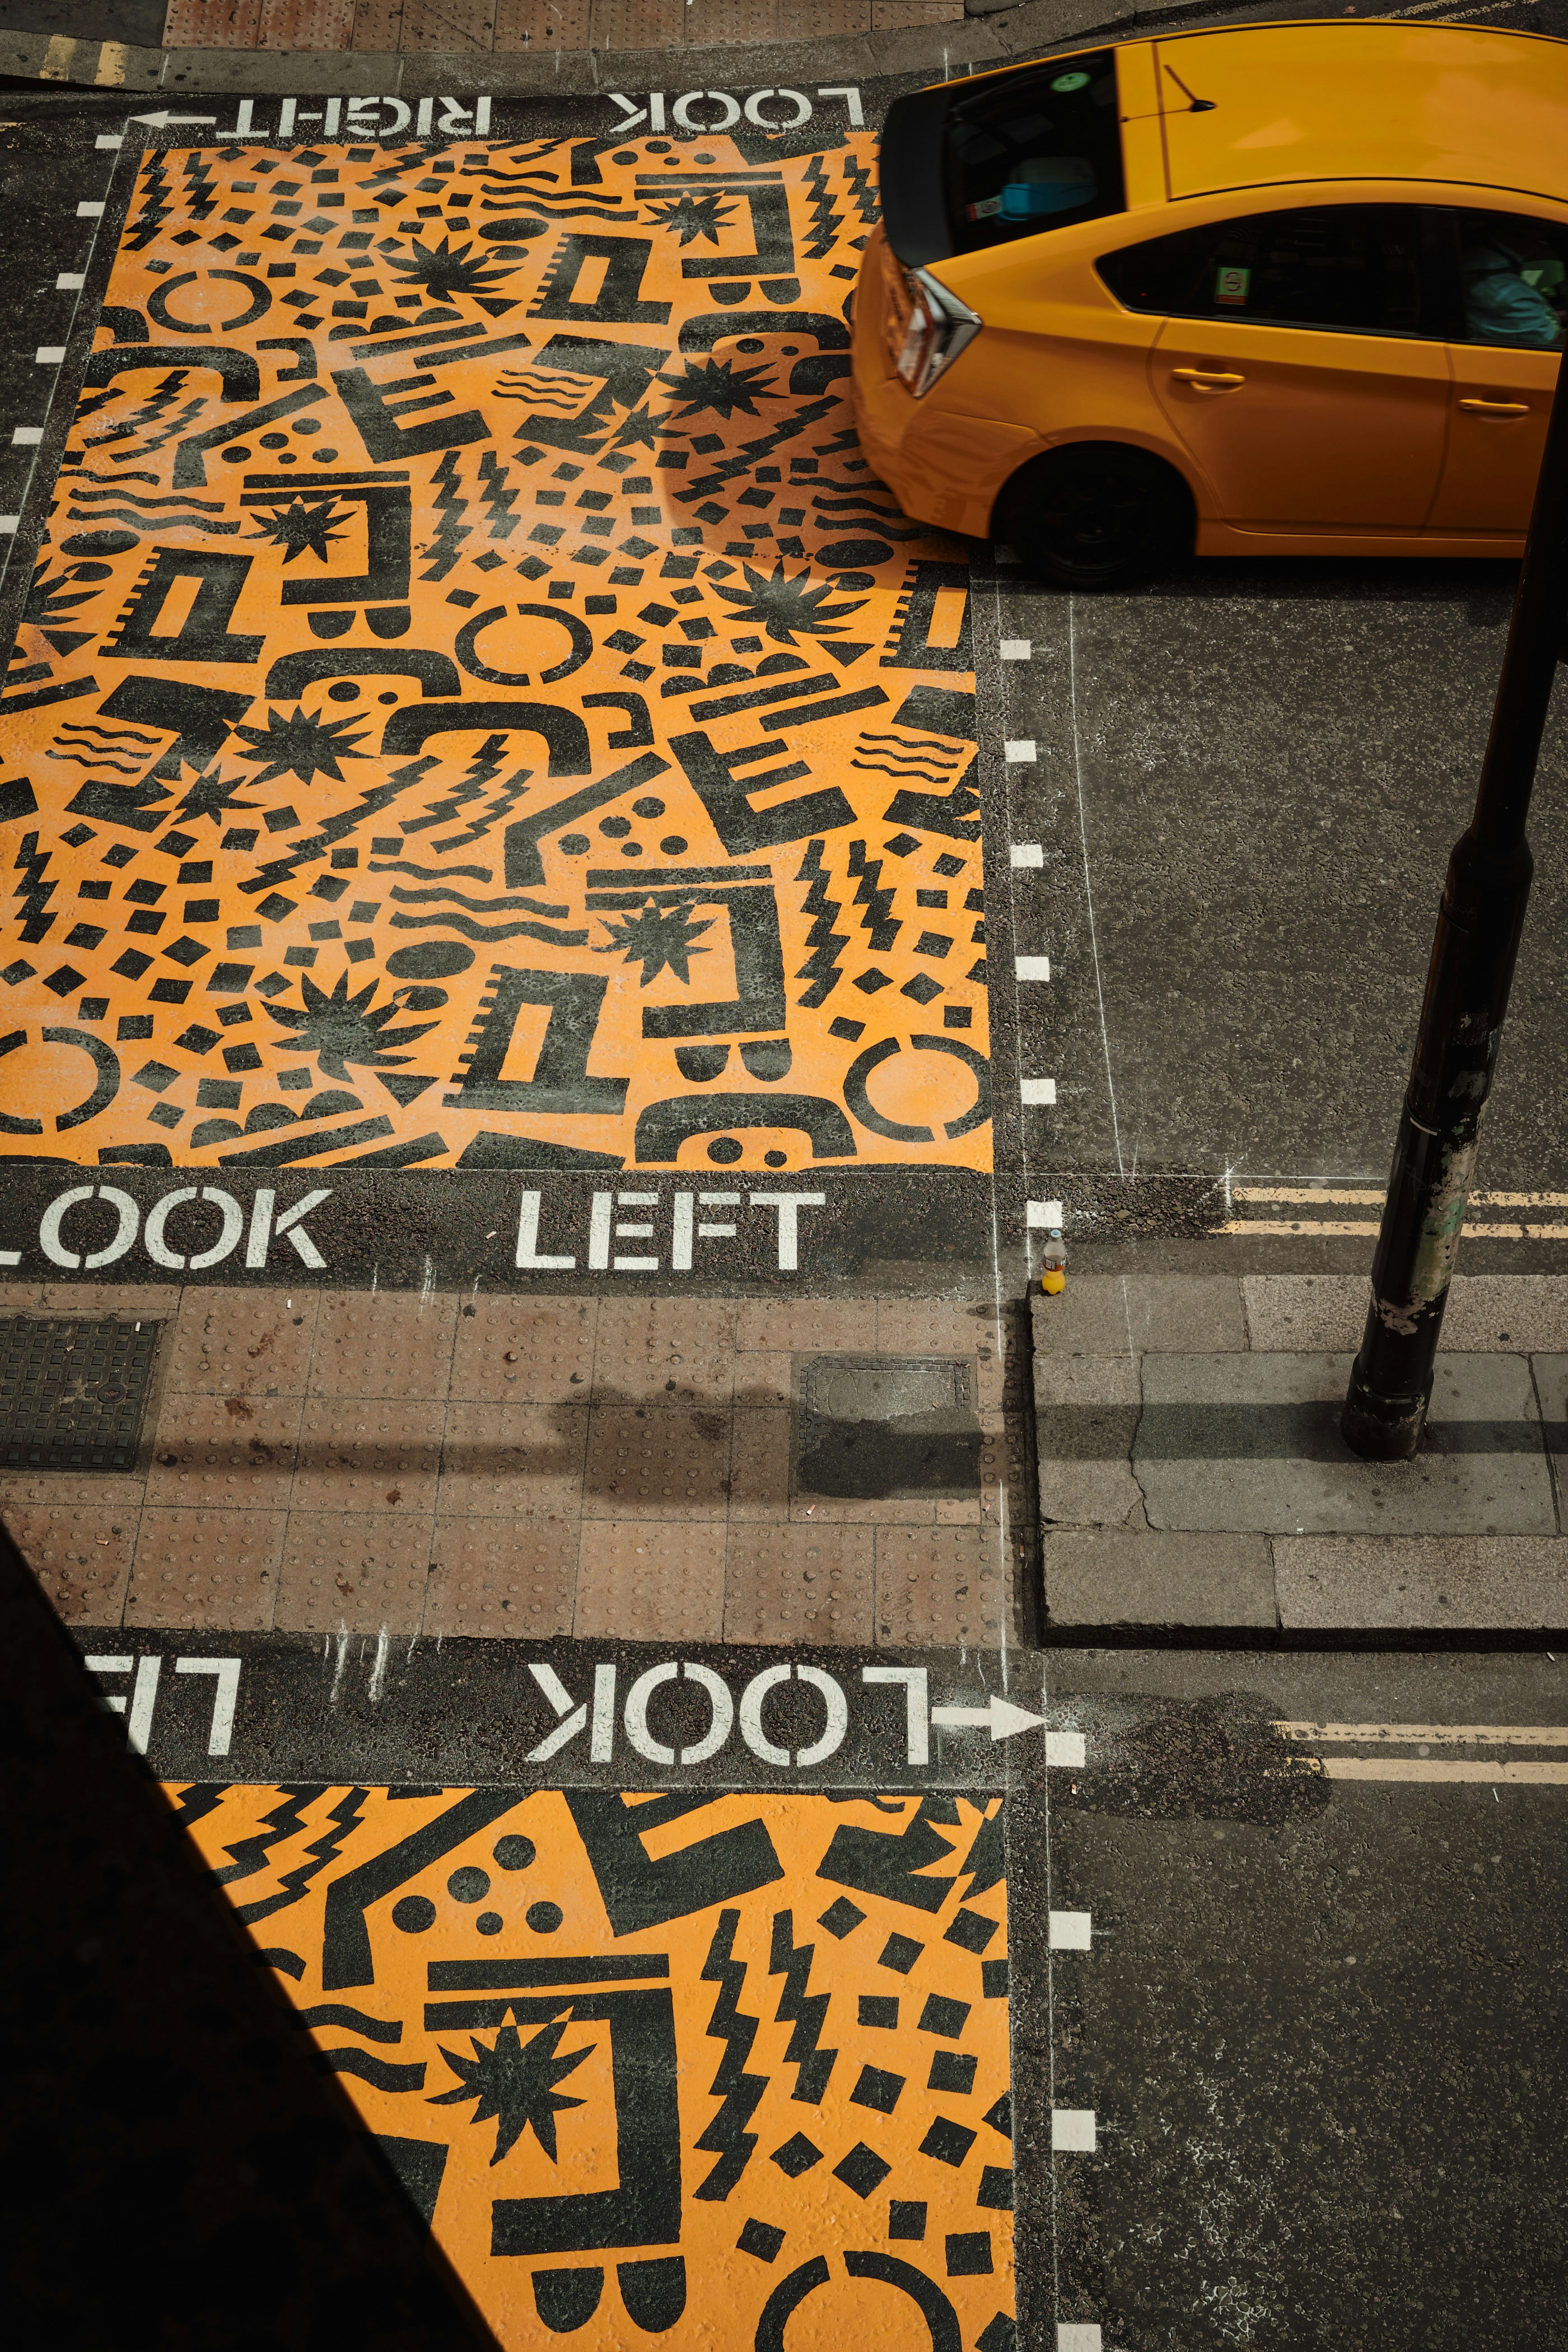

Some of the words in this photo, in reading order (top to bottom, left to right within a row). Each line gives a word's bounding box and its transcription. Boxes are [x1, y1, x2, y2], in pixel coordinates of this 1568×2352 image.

[216, 96, 492, 139] RIGHT
[608, 87, 865, 133] LOOK
[0, 1186, 333, 1270] OOK
[516, 1191, 826, 1270] LEFT
[524, 1662, 929, 1767] LOOK
